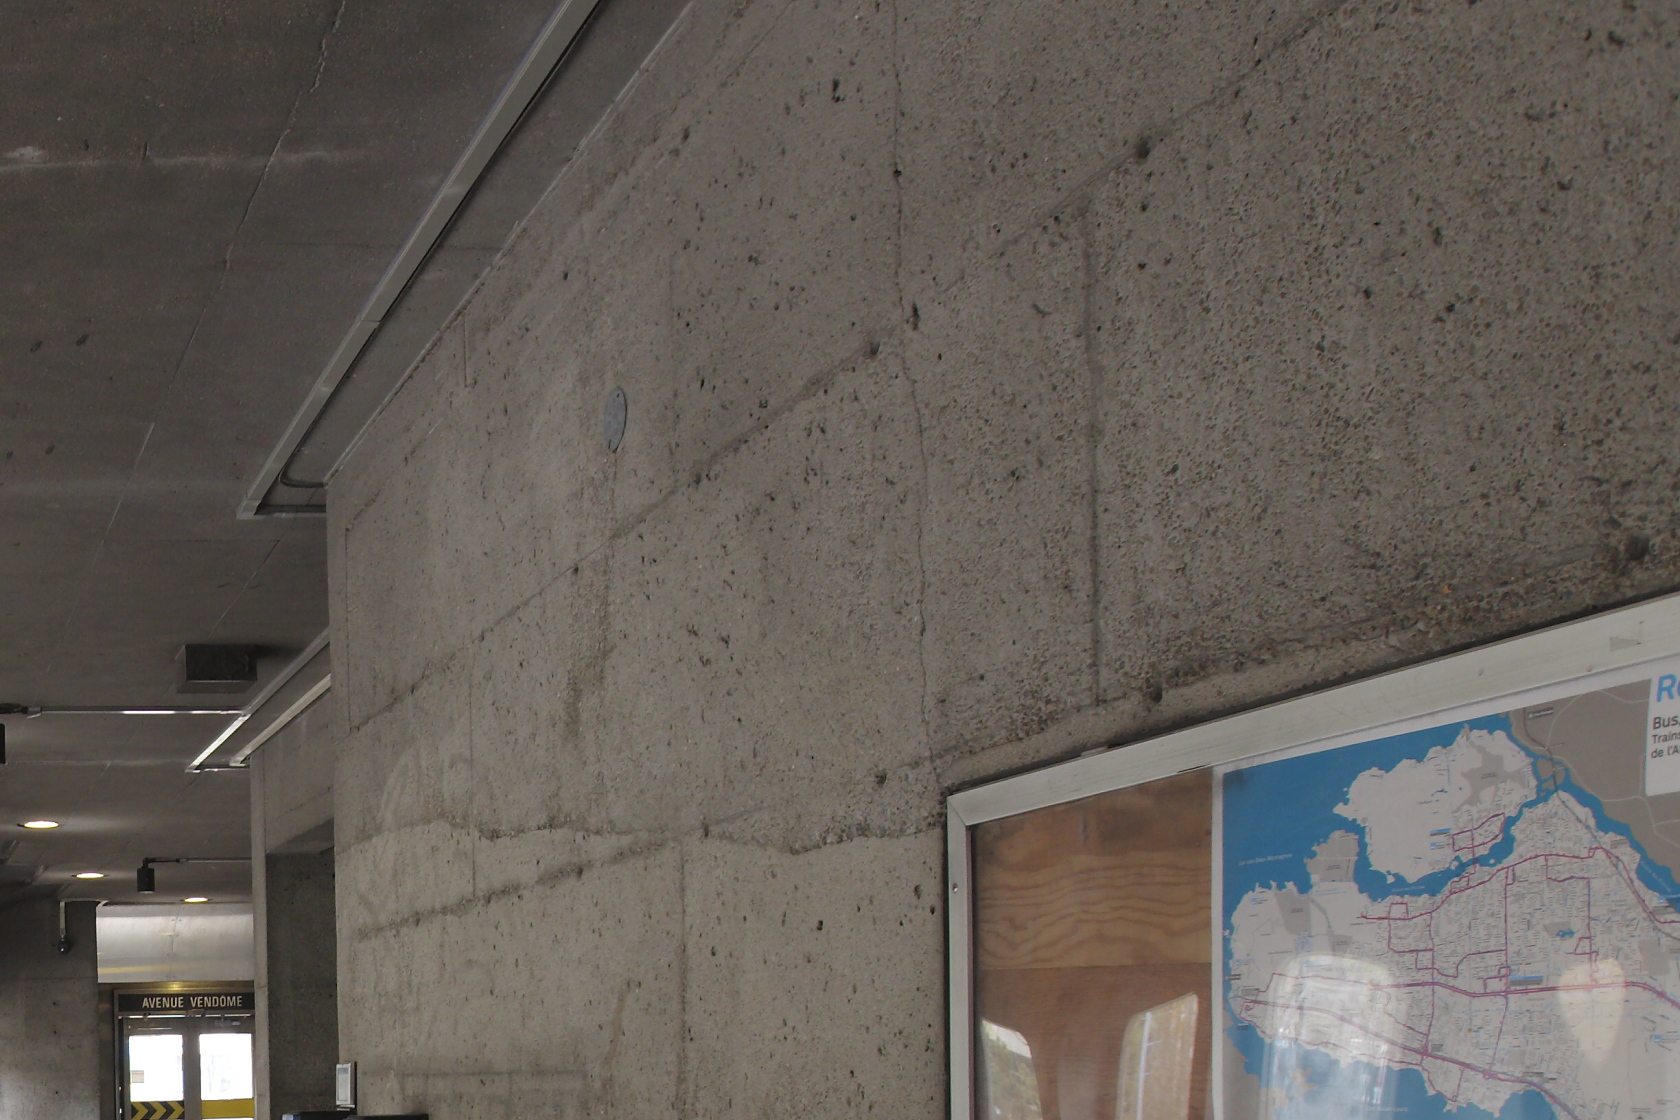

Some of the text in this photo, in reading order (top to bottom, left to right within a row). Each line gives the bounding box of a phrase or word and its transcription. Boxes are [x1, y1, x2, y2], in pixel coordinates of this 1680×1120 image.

[1657, 673, 1680, 702] R
[1651, 748, 1663, 759] de
[142, 995, 243, 1009] AVENUE VENDÔME
